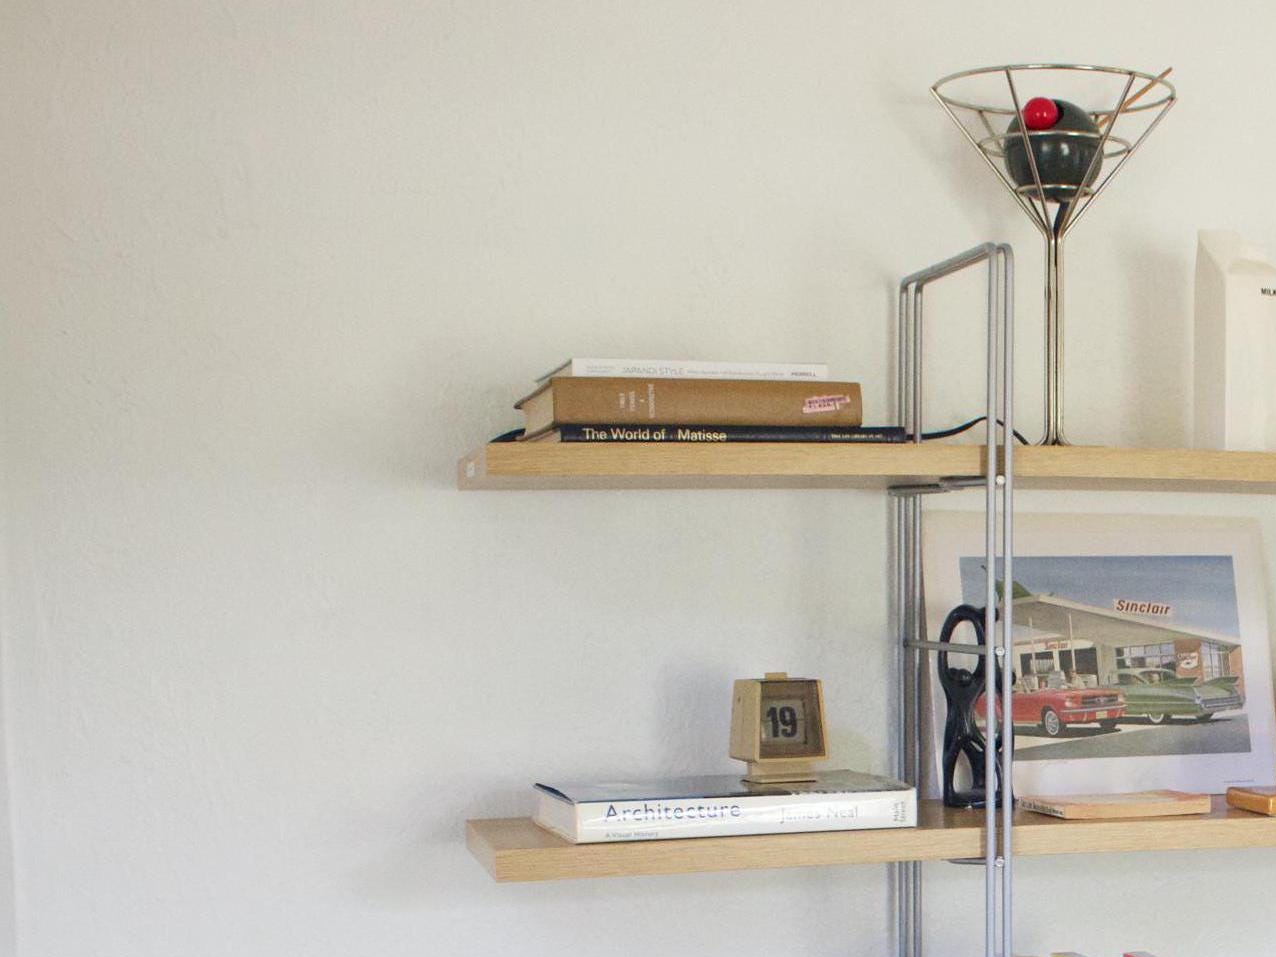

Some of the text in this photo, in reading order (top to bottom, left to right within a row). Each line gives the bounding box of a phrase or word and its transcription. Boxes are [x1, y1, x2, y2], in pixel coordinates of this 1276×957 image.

[582, 428, 727, 442] The World of Matisse
[1116, 599, 1171, 615] Sinclair
[766, 705, 798, 739] 19
[604, 803, 741, 821] Architecture
